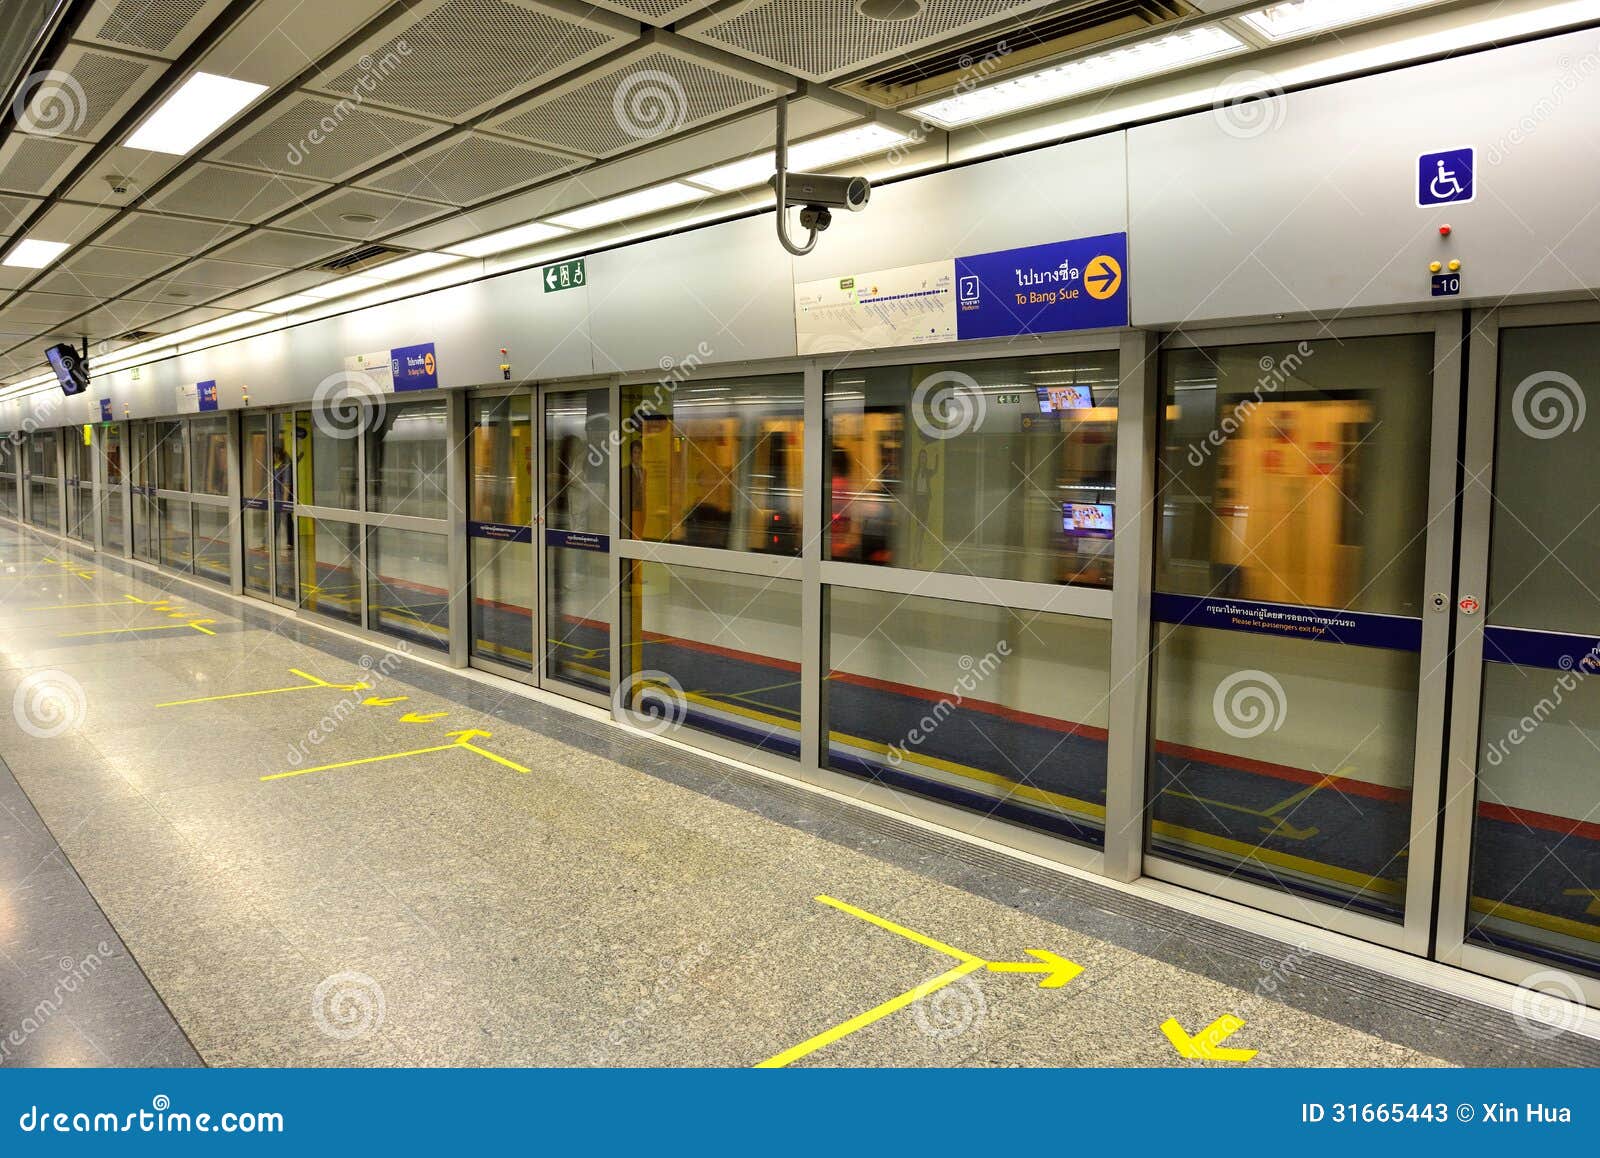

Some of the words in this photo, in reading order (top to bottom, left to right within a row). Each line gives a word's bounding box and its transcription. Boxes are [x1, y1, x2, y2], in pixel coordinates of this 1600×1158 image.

[1015, 259, 1079, 286] ไปบางซื่อ
[966, 282, 974, 296] 2
[1441, 279, 1459, 292] 10
[1015, 293, 1027, 305] To
[1029, 291, 1056, 304] Bang
[1059, 288, 1079, 300] Sue
[1231, 617, 1252, 626] Please
[1252, 619, 1261, 627] let
[1262, 622, 1297, 631] passengers
[1312, 626, 1325, 634] first
